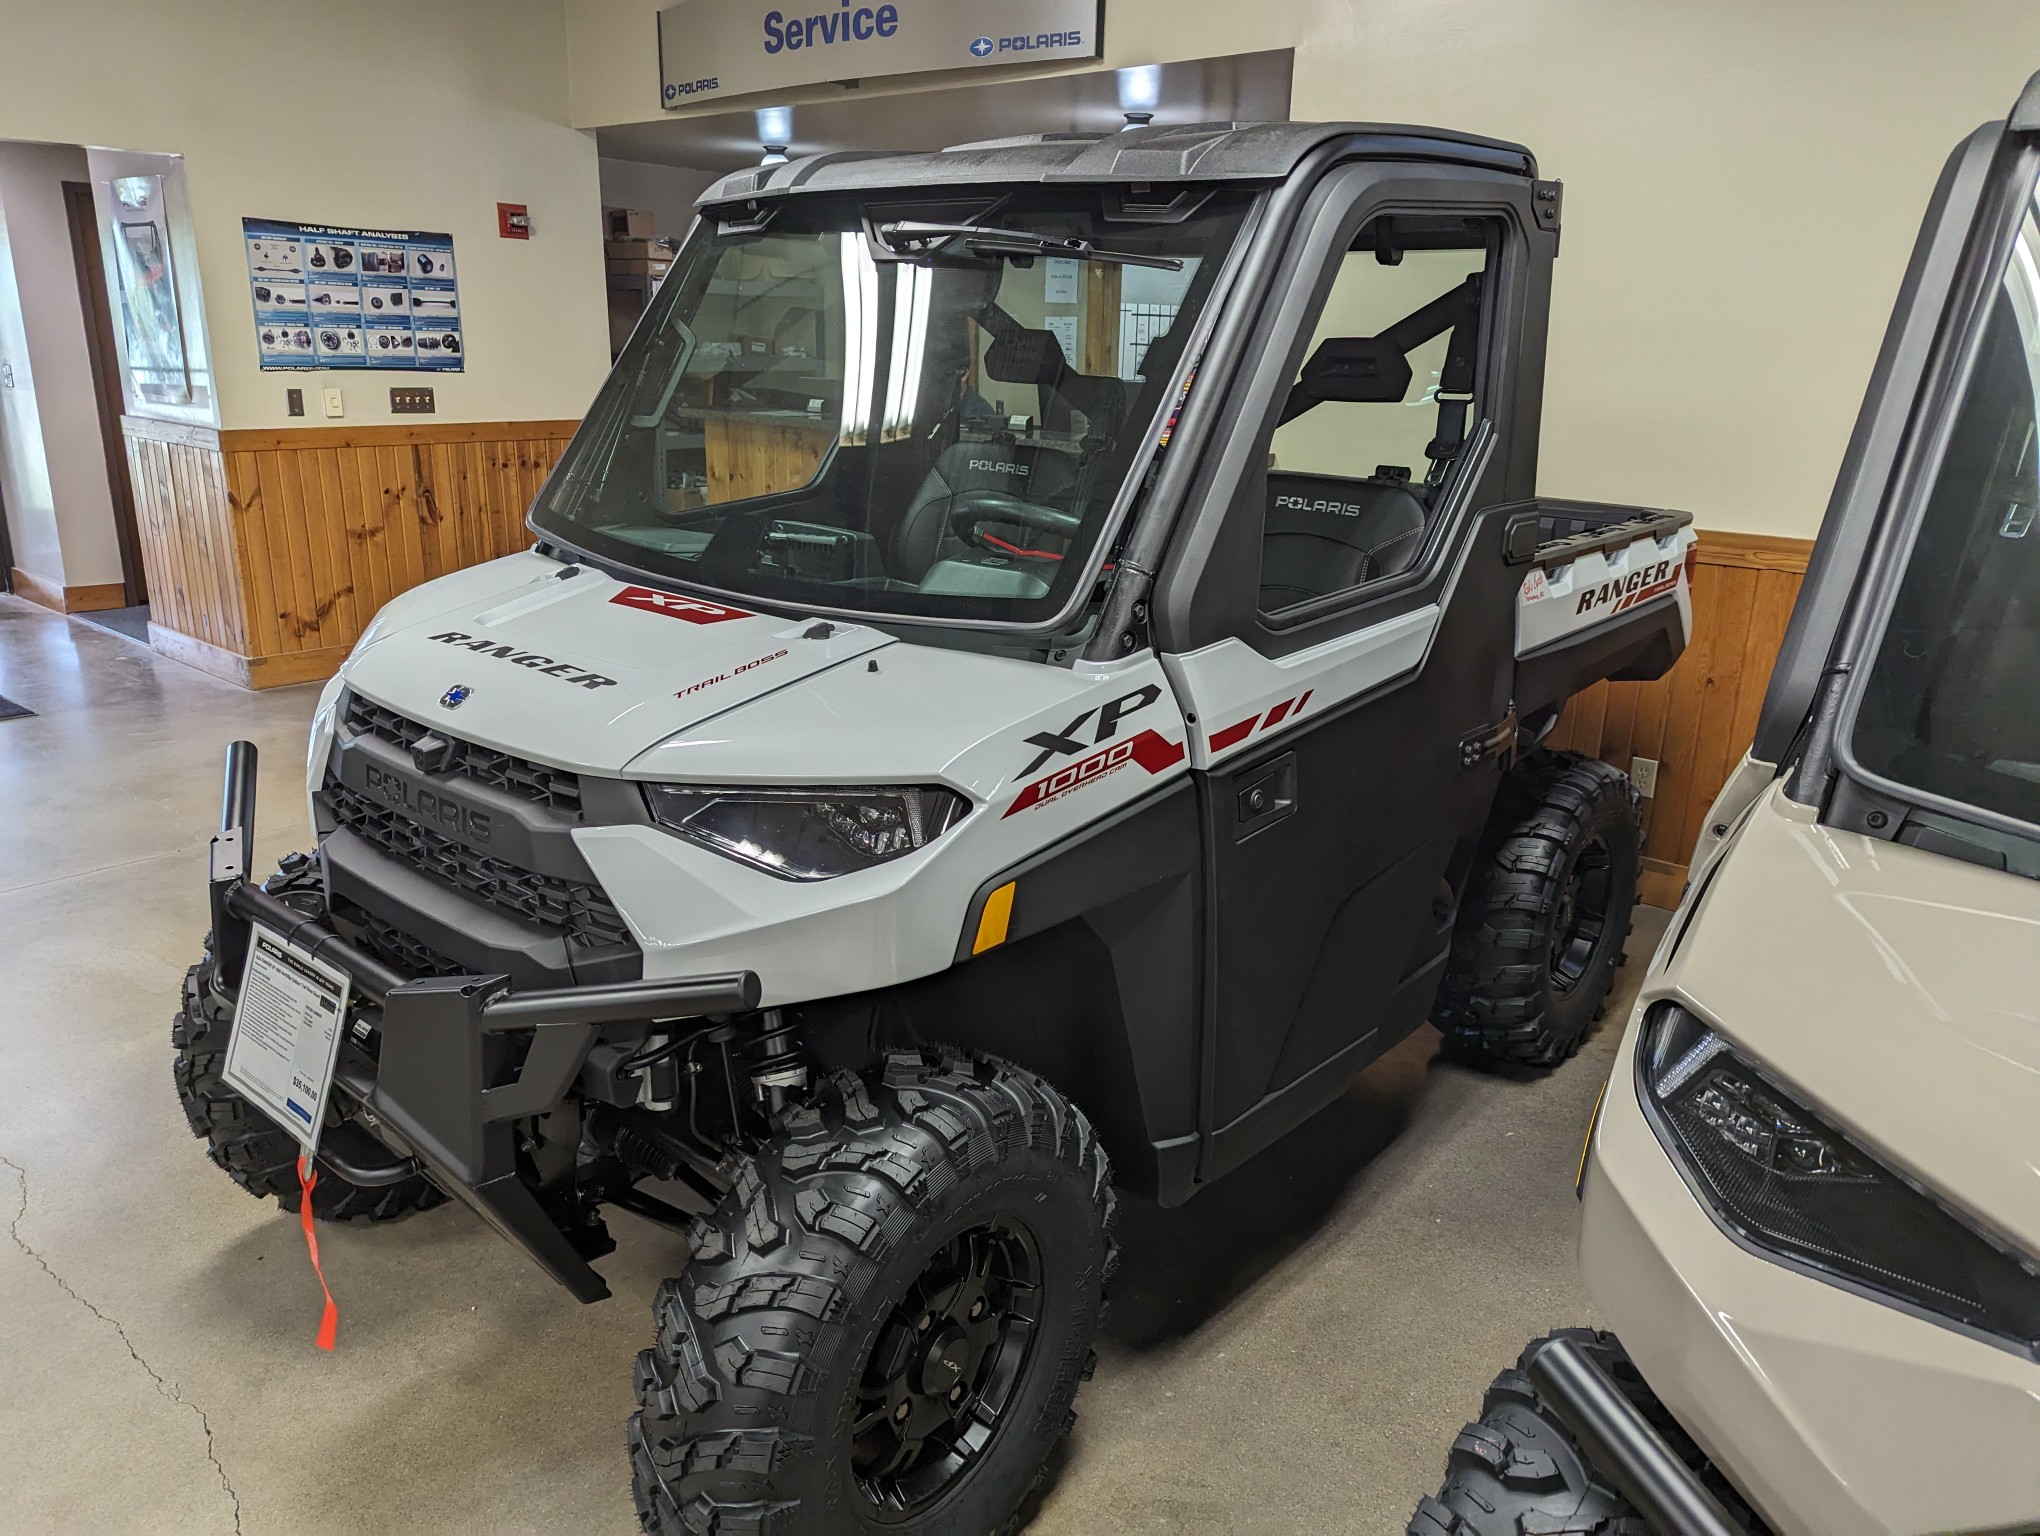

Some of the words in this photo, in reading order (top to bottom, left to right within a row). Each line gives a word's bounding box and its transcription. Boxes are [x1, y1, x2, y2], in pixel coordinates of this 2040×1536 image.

[763, 0, 899, 54] Service
[998, 31, 1082, 52] POLARIS
[678, 77, 719, 96] POLARIS
[298, 225, 325, 233] HALF
[327, 228, 359, 236] SHAFT
[361, 231, 409, 240] ANALYSIS
[969, 459, 1029, 475] POLARIS
[1275, 495, 1360, 517] POLARIS
[1576, 559, 1670, 615] RANGER
[625, 593, 727, 617] XP
[427, 631, 618, 690] RANGER
[673, 674, 731, 699] TRAIL
[734, 649, 788, 675] BOSS
[1011, 683, 1162, 783] XP
[1034, 796, 1059, 810] DUAL
[1061, 772, 1108, 797] OVERHEAD
[1108, 763, 1128, 775] CAM
[1037, 741, 1134, 800] 1000
[365, 763, 491, 845] POLARIS
[261, 941, 282, 959] POLARIS
[943, 1360, 961, 1373] XP
